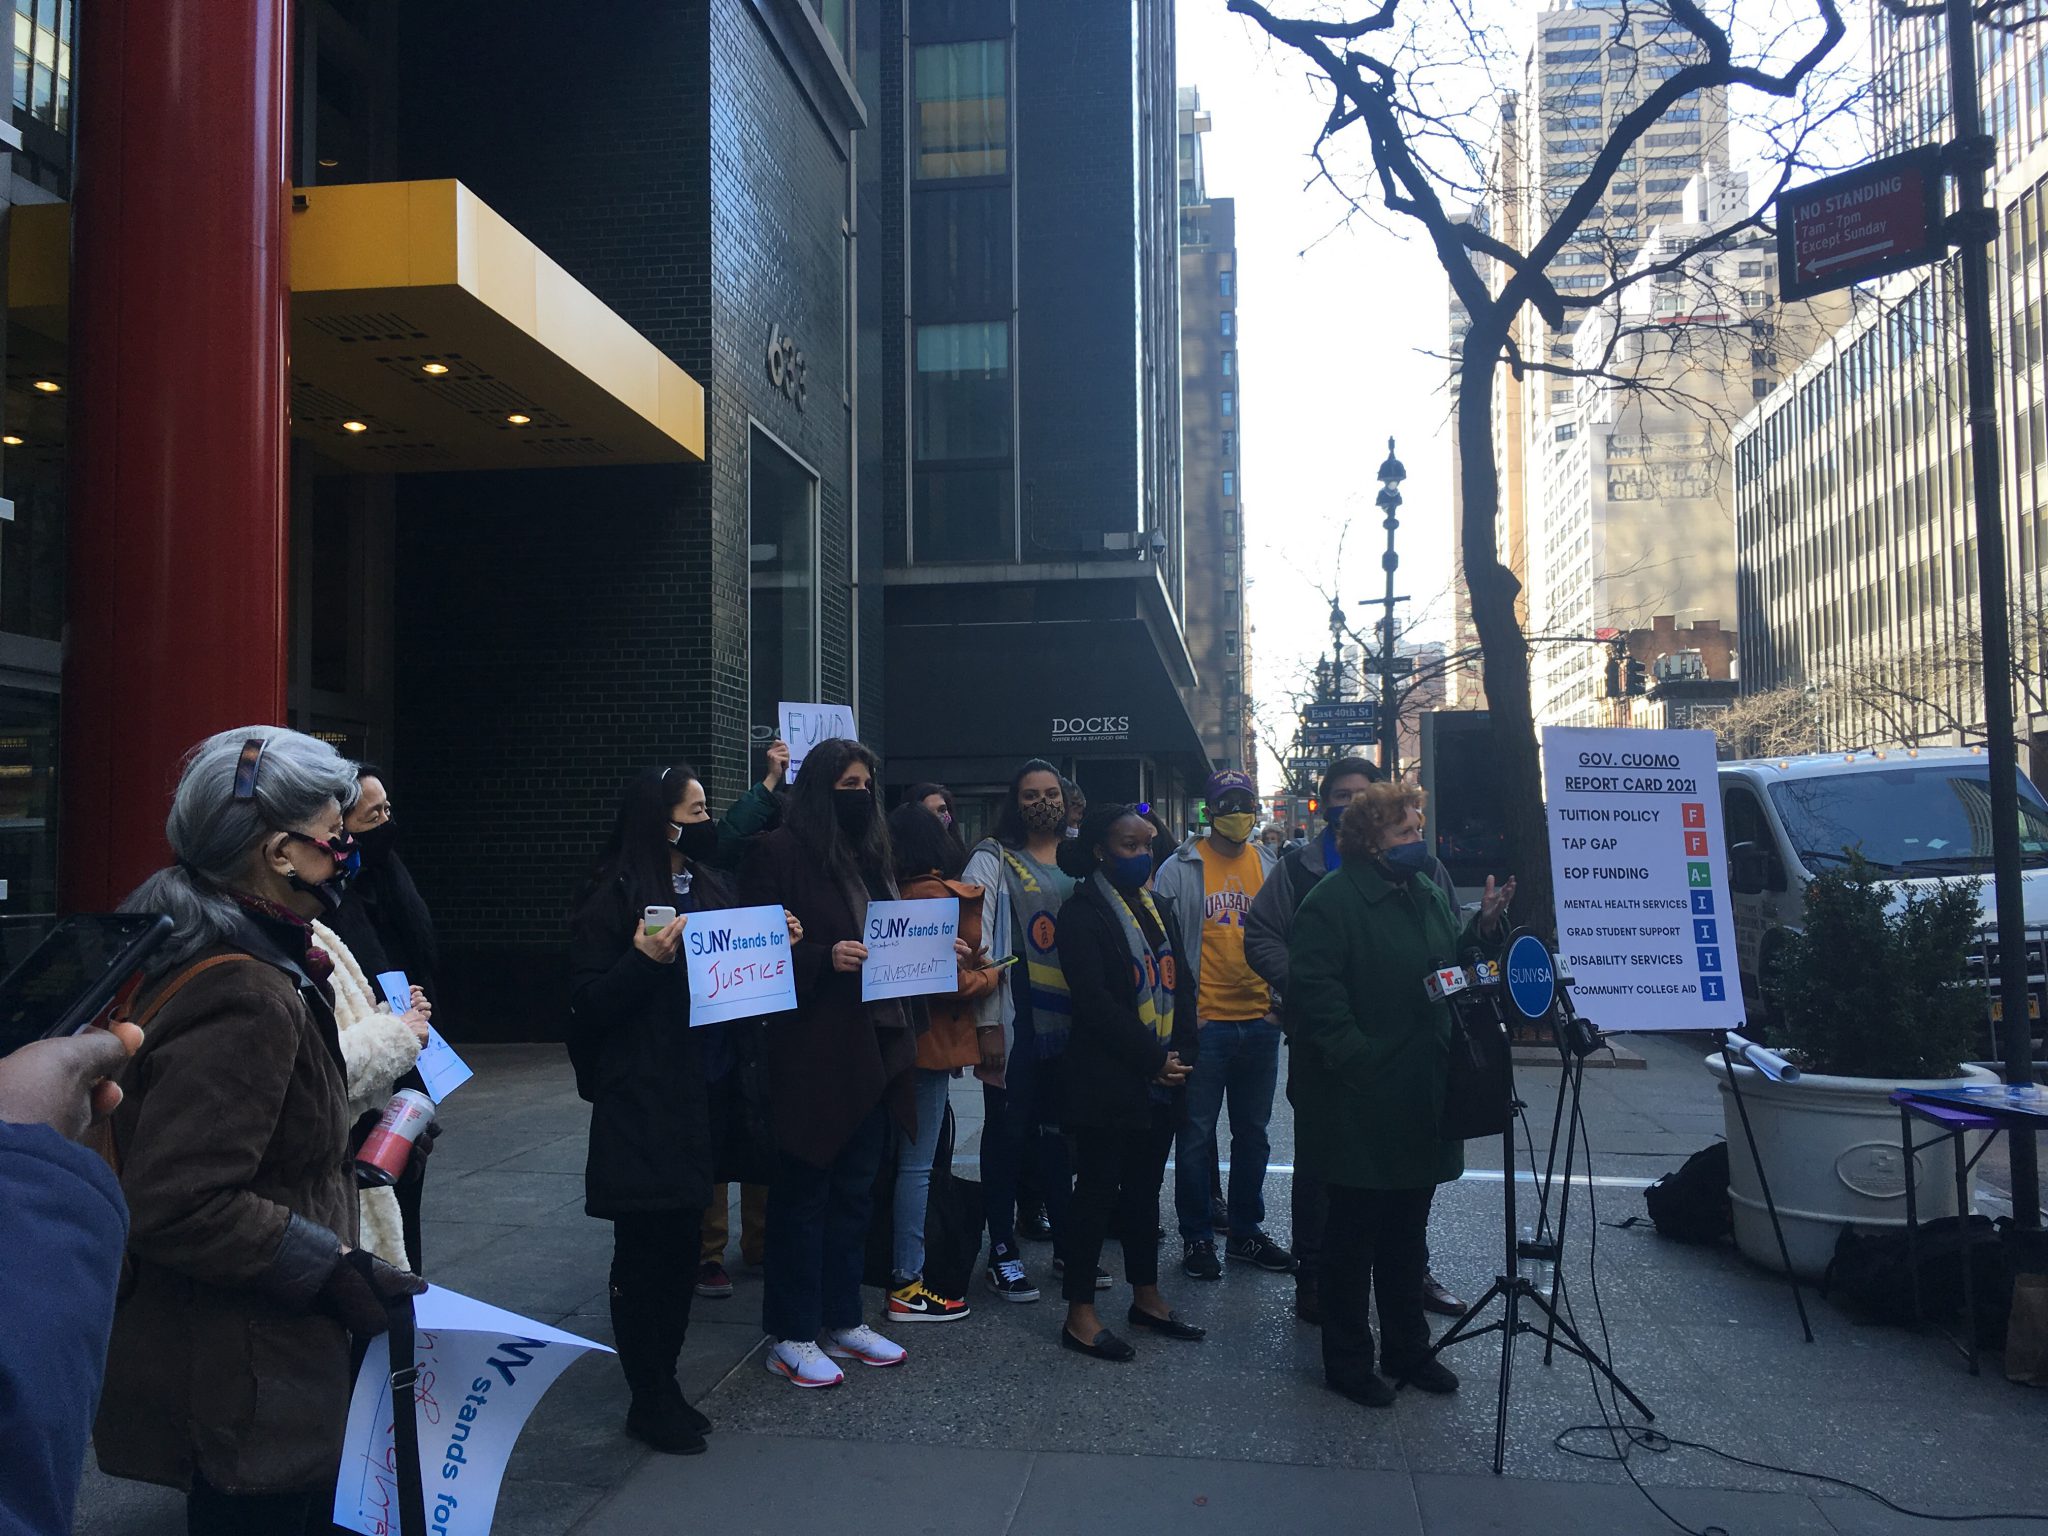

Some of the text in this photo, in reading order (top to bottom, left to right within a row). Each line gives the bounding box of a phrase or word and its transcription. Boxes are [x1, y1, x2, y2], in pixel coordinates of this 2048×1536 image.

[1800, 176, 1902, 221] NO STANDING
[1801, 223, 1826, 239] 7am
[1836, 211, 1862, 230] 7pm
[1802, 220, 1887, 255] Except Sunday
[768, 323, 806, 412] 633
[1311, 707, 1369, 719] East 40th St
[788, 712, 844, 745] FUND
[1052, 716, 1129, 733] DOCKS
[1578, 753, 1680, 768] GOV. CUOMO
[1565, 776, 1697, 792] REPORT CARD 2021
[1559, 809, 1697, 823] TUITION POLICY F
[1562, 837, 1701, 851] TAP GAP F
[1564, 867, 1708, 882] EOP FUNDING A-
[1564, 896, 1706, 910] MENTAL HEALTH SERVICES I
[869, 917, 955, 940] SUNY stands for
[1566, 925, 1710, 938] GRAD STUDENT SUPPORT I
[690, 928, 785, 956] SUNY stands for
[1487, 960, 1500, 975] 2
[1559, 959, 1571, 974] 41
[1570, 953, 1713, 967] DISABILITY SERVICES I
[870, 957, 947, 984] INVESTMENT
[1511, 968, 1552, 984] SUNYSA
[708, 960, 786, 998] JUSTICE
[1454, 977, 1463, 986] 47
[1573, 982, 1718, 996] COMMUNITY COLLEGE AID I
[441, 1375, 492, 1481] stands
[431, 1492, 459, 1536] for
